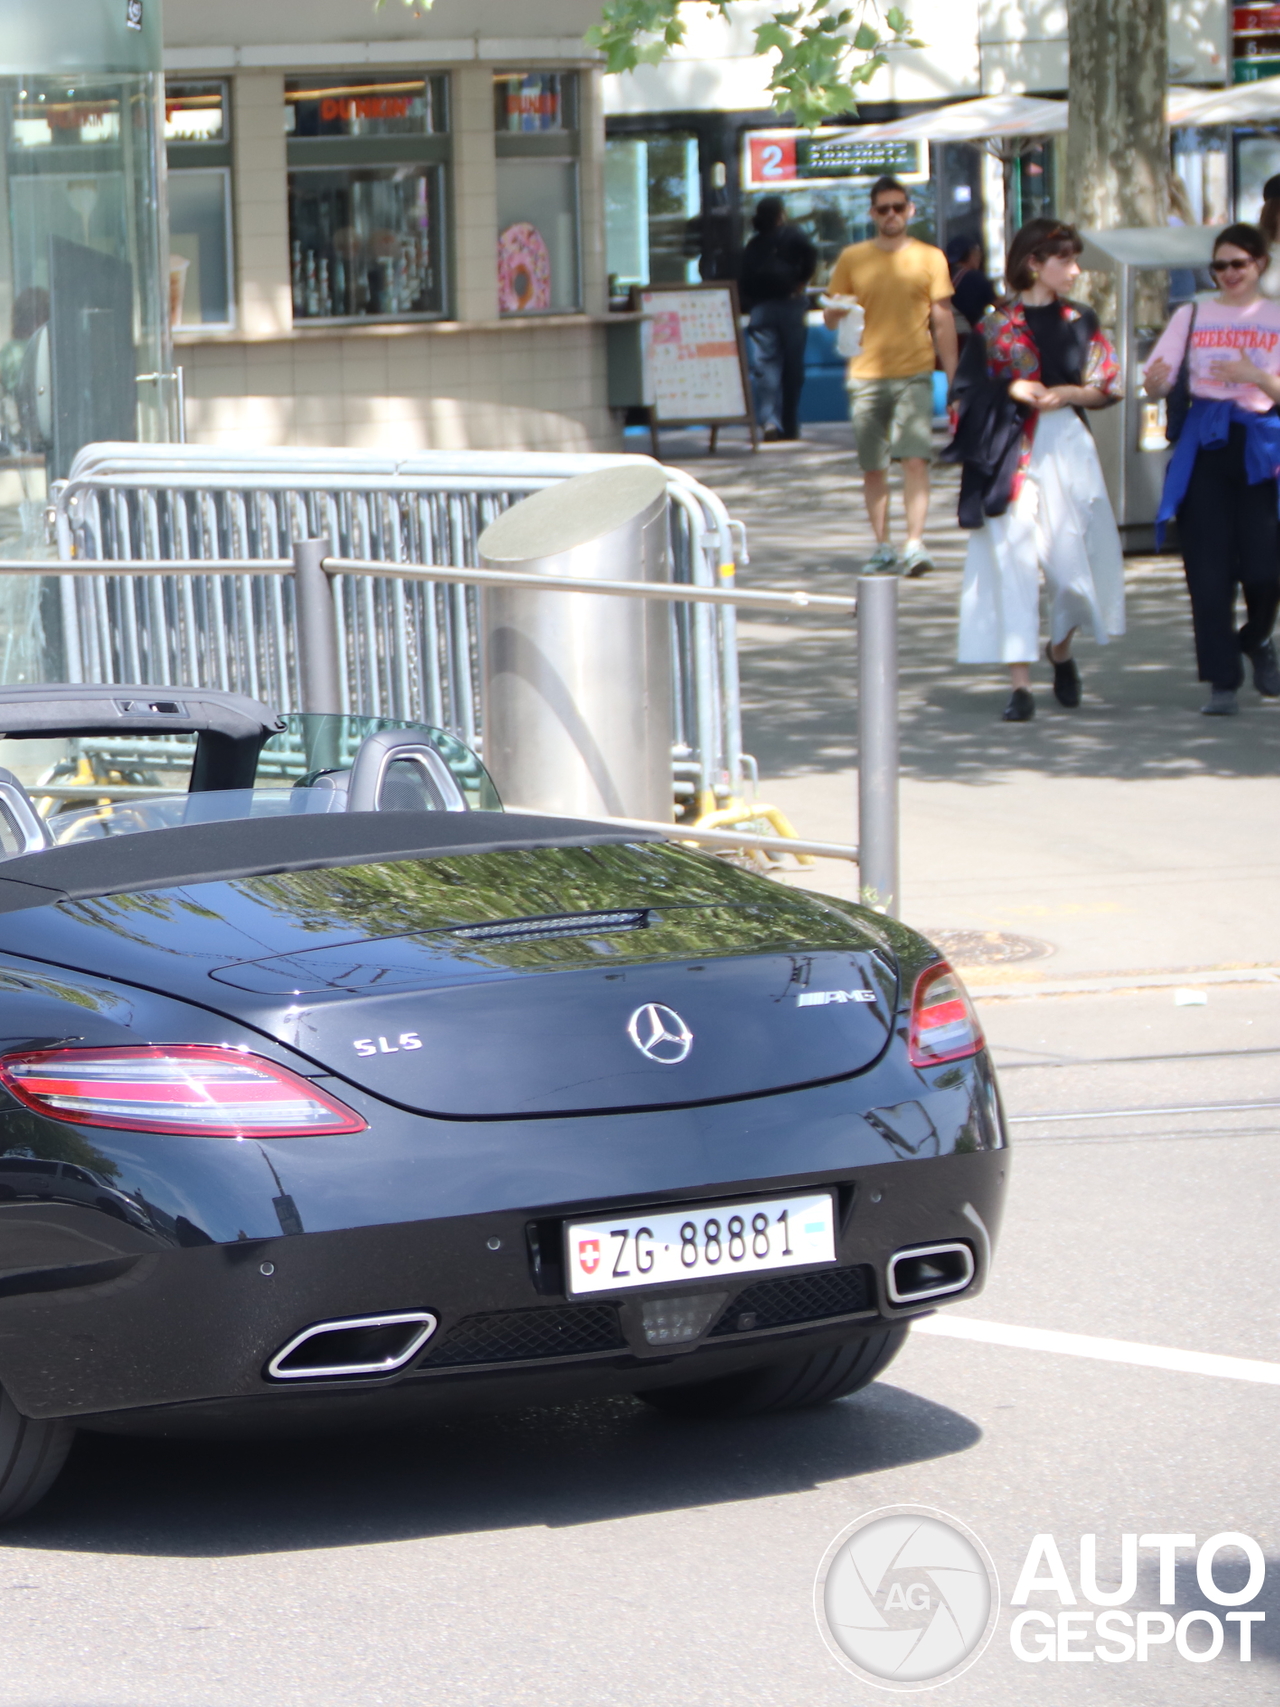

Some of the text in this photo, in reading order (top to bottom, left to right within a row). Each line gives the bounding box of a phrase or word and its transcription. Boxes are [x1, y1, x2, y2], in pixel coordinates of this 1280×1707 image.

[762, 145, 783, 176] 2
[610, 1209, 794, 1278] ZG 88881
